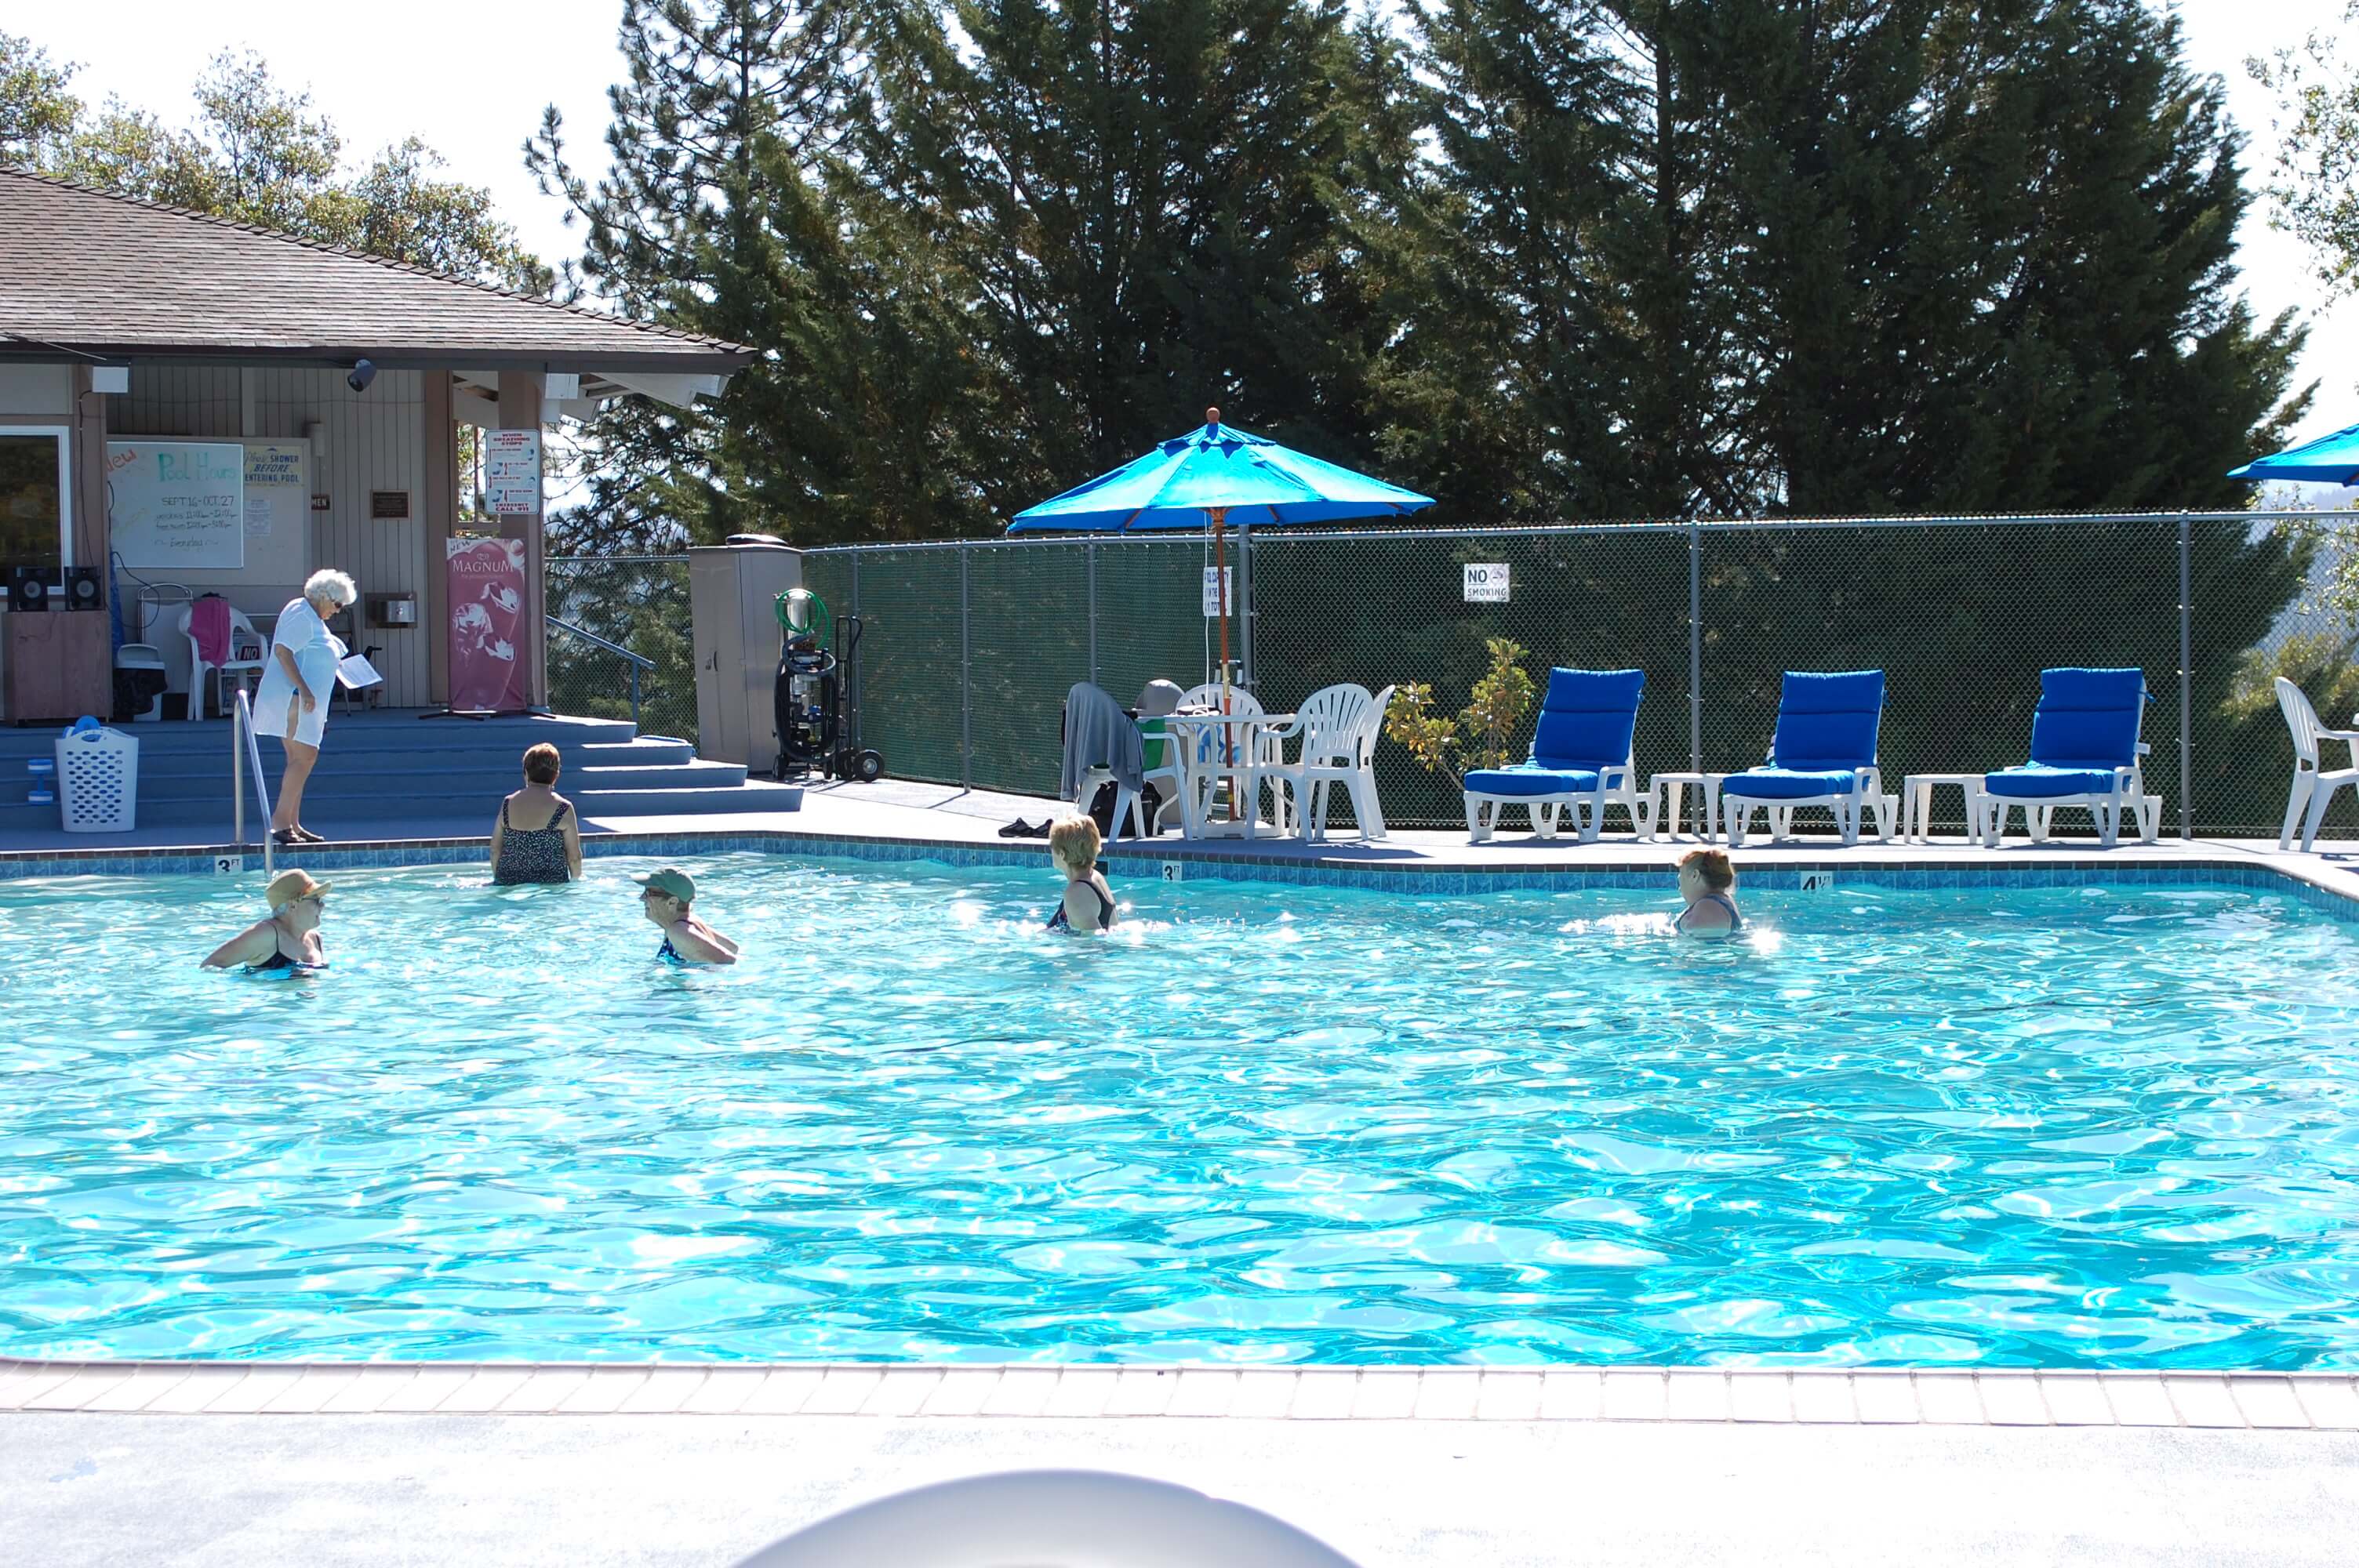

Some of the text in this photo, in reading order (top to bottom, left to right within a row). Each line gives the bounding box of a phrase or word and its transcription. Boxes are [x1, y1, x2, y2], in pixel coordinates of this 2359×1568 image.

[157, 452, 237, 481] Pool Hours
[245, 474, 278, 482] ENTERING
[451, 541, 471, 553] NEW
[453, 559, 514, 572] MAGNUM
[1468, 569, 1488, 583] NO
[1467, 588, 1506, 597] SMOKING
[243, 648, 257, 659] NO
[218, 859, 230, 873] 3
[1165, 866, 1172, 880] 3
[1802, 877, 1816, 891] 4
